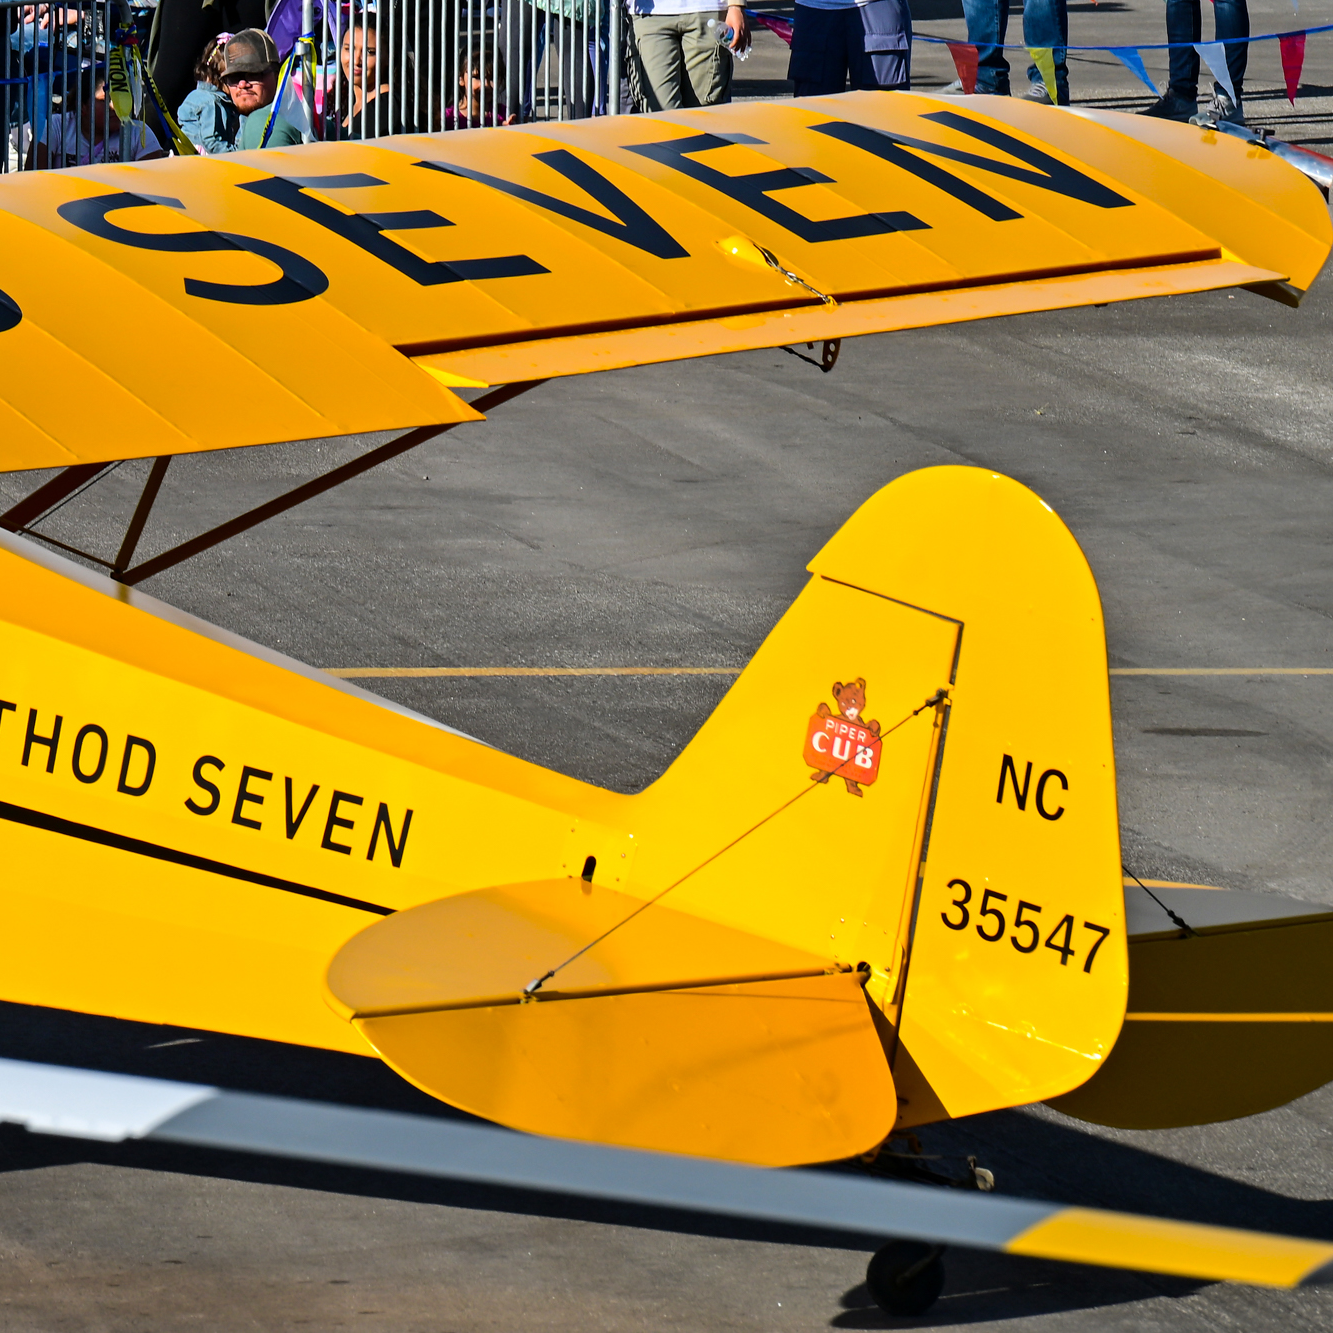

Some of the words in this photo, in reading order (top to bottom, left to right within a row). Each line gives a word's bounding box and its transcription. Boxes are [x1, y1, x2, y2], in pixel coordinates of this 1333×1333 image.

[56, 110, 1136, 306] SEVEN
[812, 731, 874, 769] CUB
[825, 719, 867, 743] PIPER
[183, 754, 414, 869] SEVEN
[995, 753, 1069, 822] NC
[940, 878, 1111, 975] 35547
